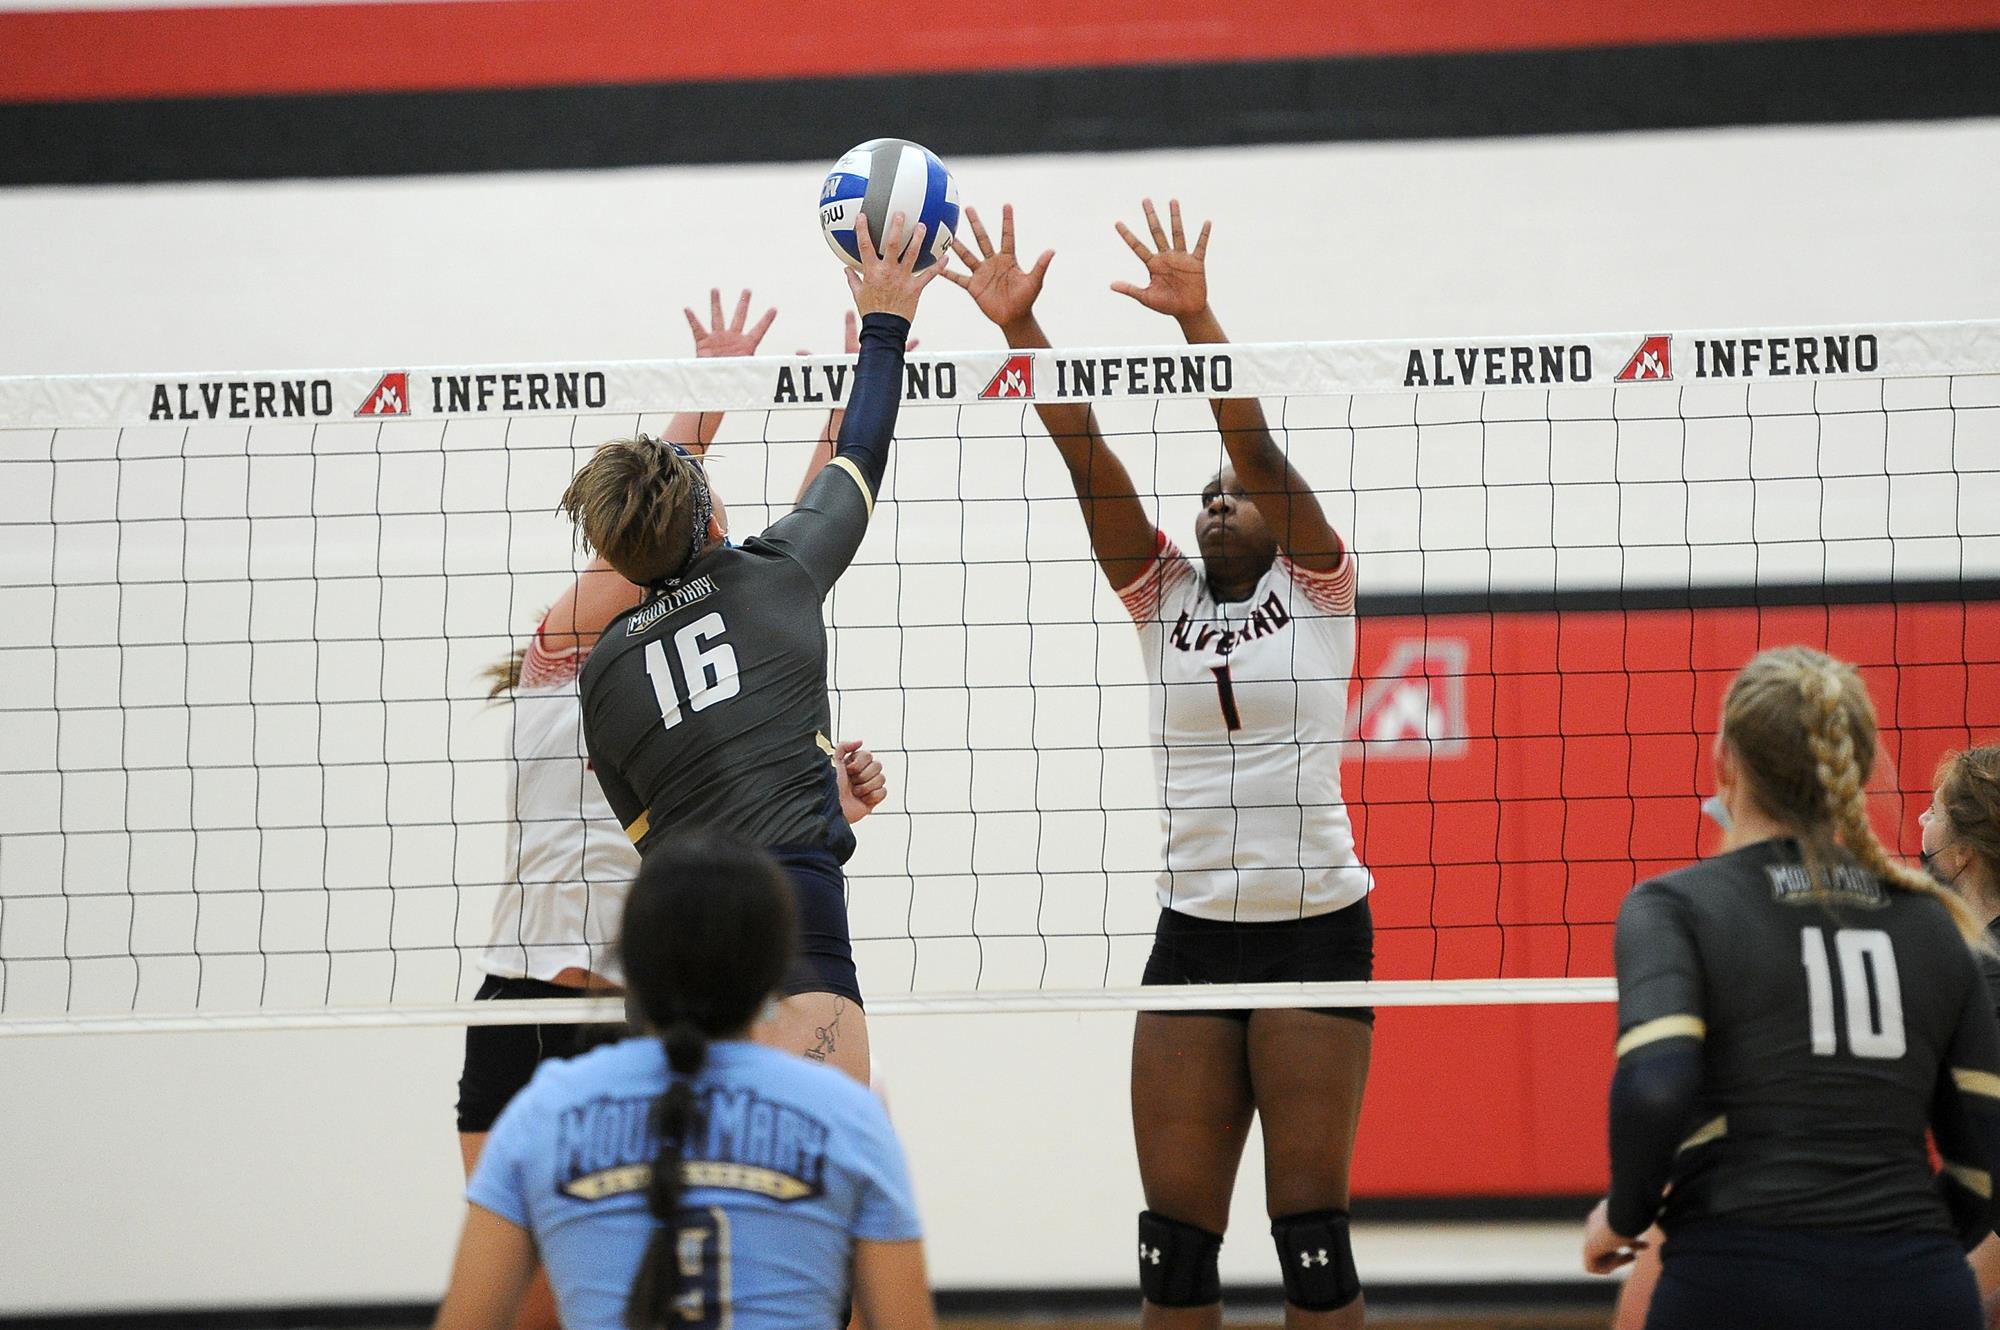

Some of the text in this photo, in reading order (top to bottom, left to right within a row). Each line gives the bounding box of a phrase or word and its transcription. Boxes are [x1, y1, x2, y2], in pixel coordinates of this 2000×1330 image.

[774, 362, 957, 403] ALVNO
[1056, 355, 1233, 398] INFERNO
[1403, 344, 1593, 387] ALVERNO
[1694, 334, 1878, 378] INFERNO
[149, 380, 333, 420] ALVERNO
[432, 372, 606, 413] INFERNO
[630, 576, 713, 632] MOUNT MARY
[645, 611, 741, 730] 16
[1209, 665, 1242, 731] 1
[1801, 926, 1906, 1059] 10
